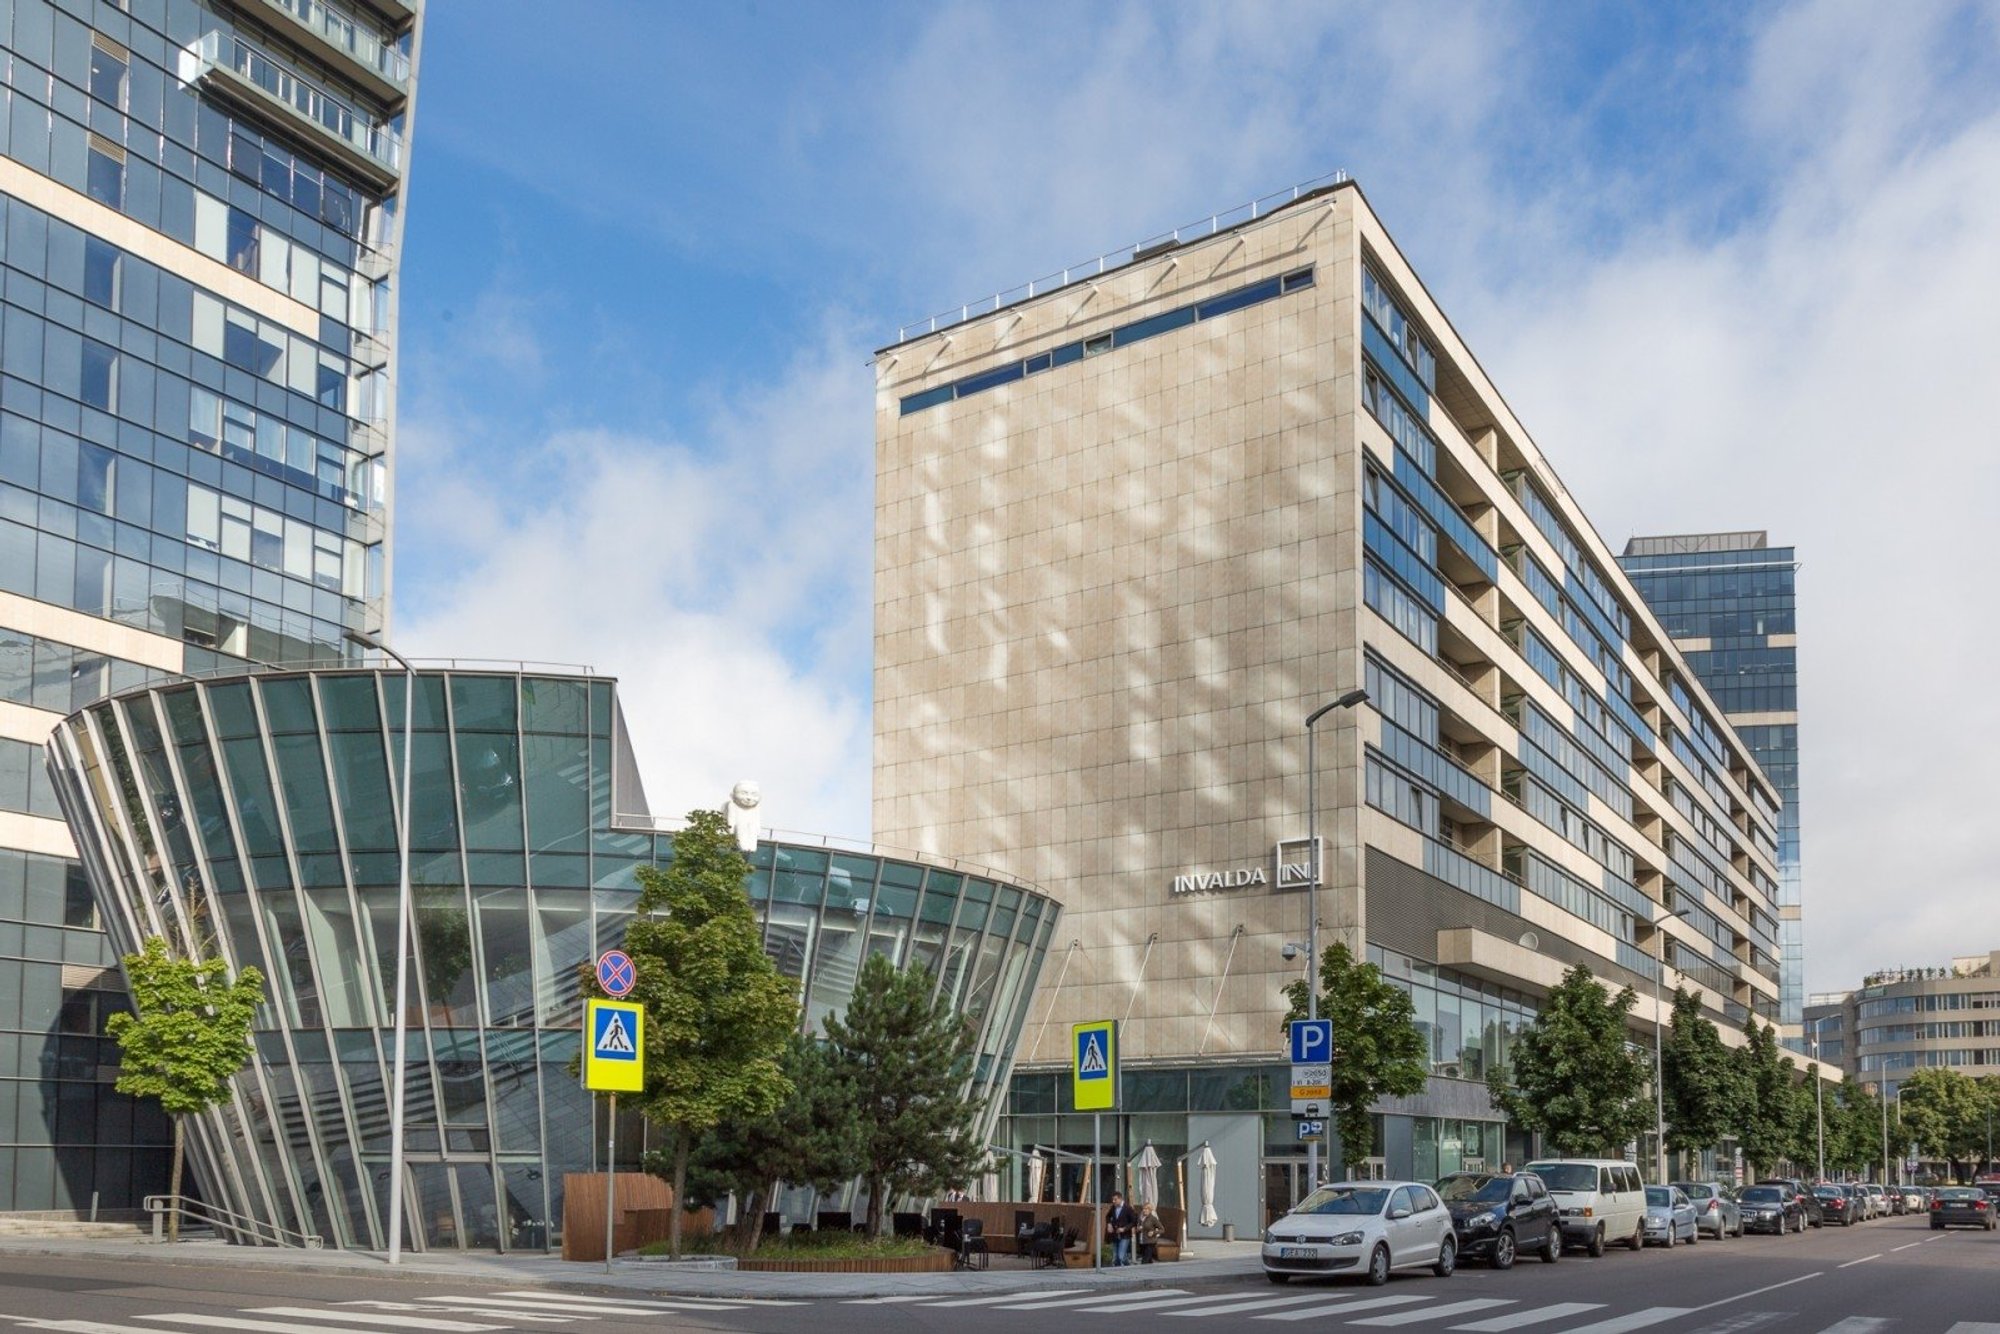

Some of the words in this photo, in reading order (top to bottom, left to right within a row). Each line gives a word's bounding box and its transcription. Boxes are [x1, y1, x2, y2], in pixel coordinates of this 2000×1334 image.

[1174, 867, 1267, 892] INVALDA
[1302, 1025, 1324, 1059] P
[1299, 1122, 1310, 1140] P
